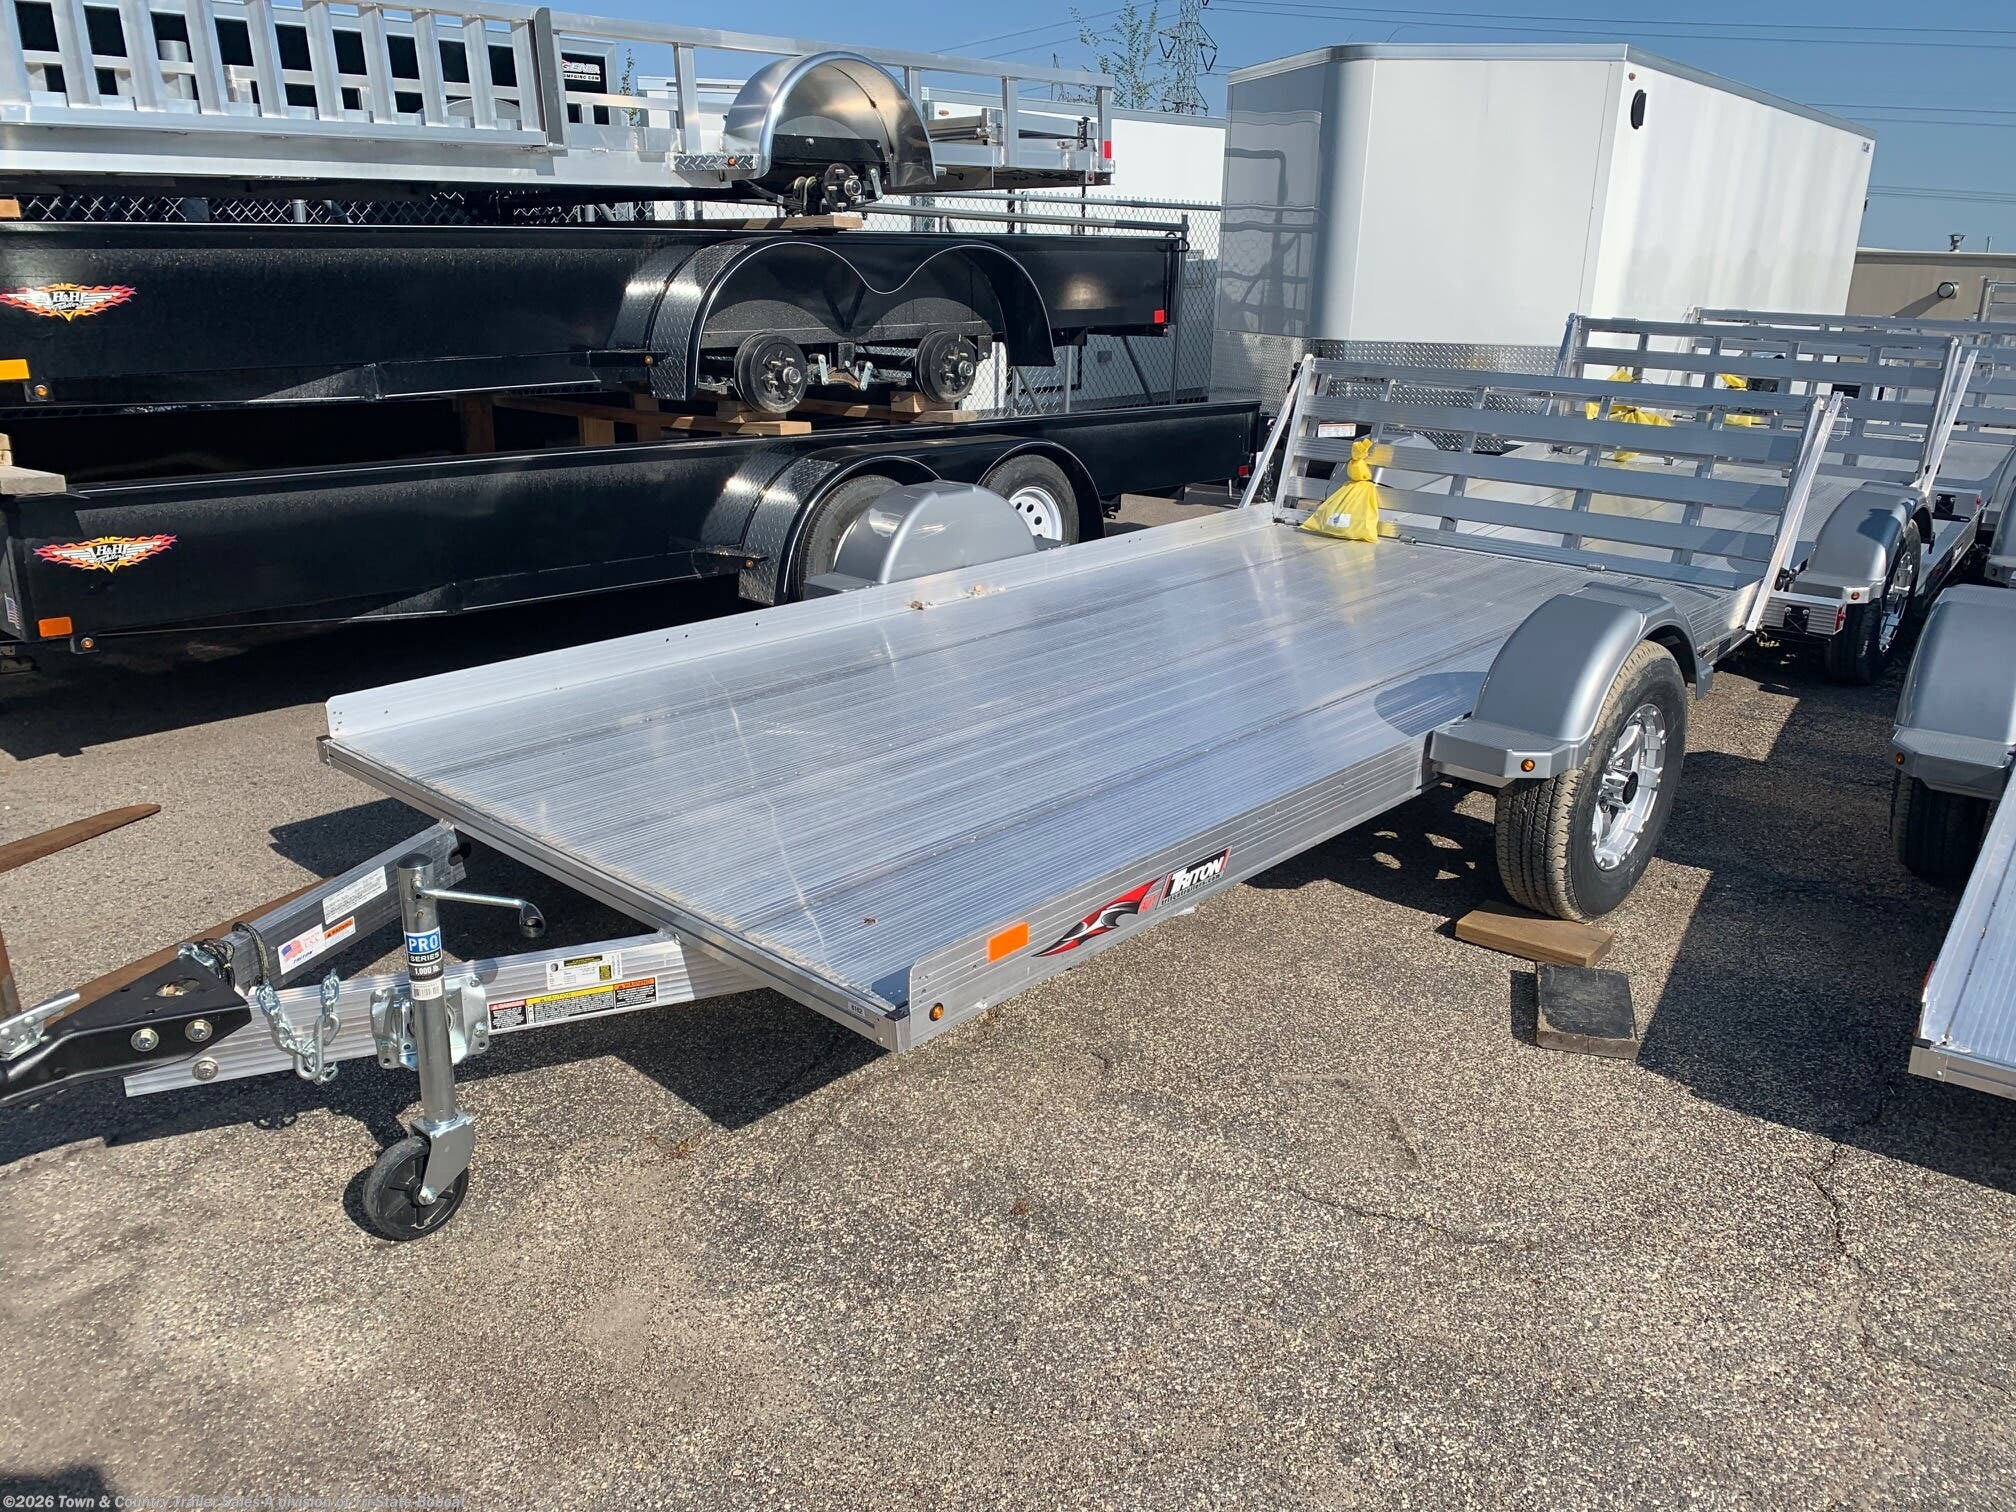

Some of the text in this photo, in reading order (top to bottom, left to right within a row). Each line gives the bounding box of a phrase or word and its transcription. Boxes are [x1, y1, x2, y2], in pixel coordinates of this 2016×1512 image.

[1170, 856, 1225, 895] TRITON
[408, 935, 438, 952] PRO
[410, 952, 440, 962] SERIES
